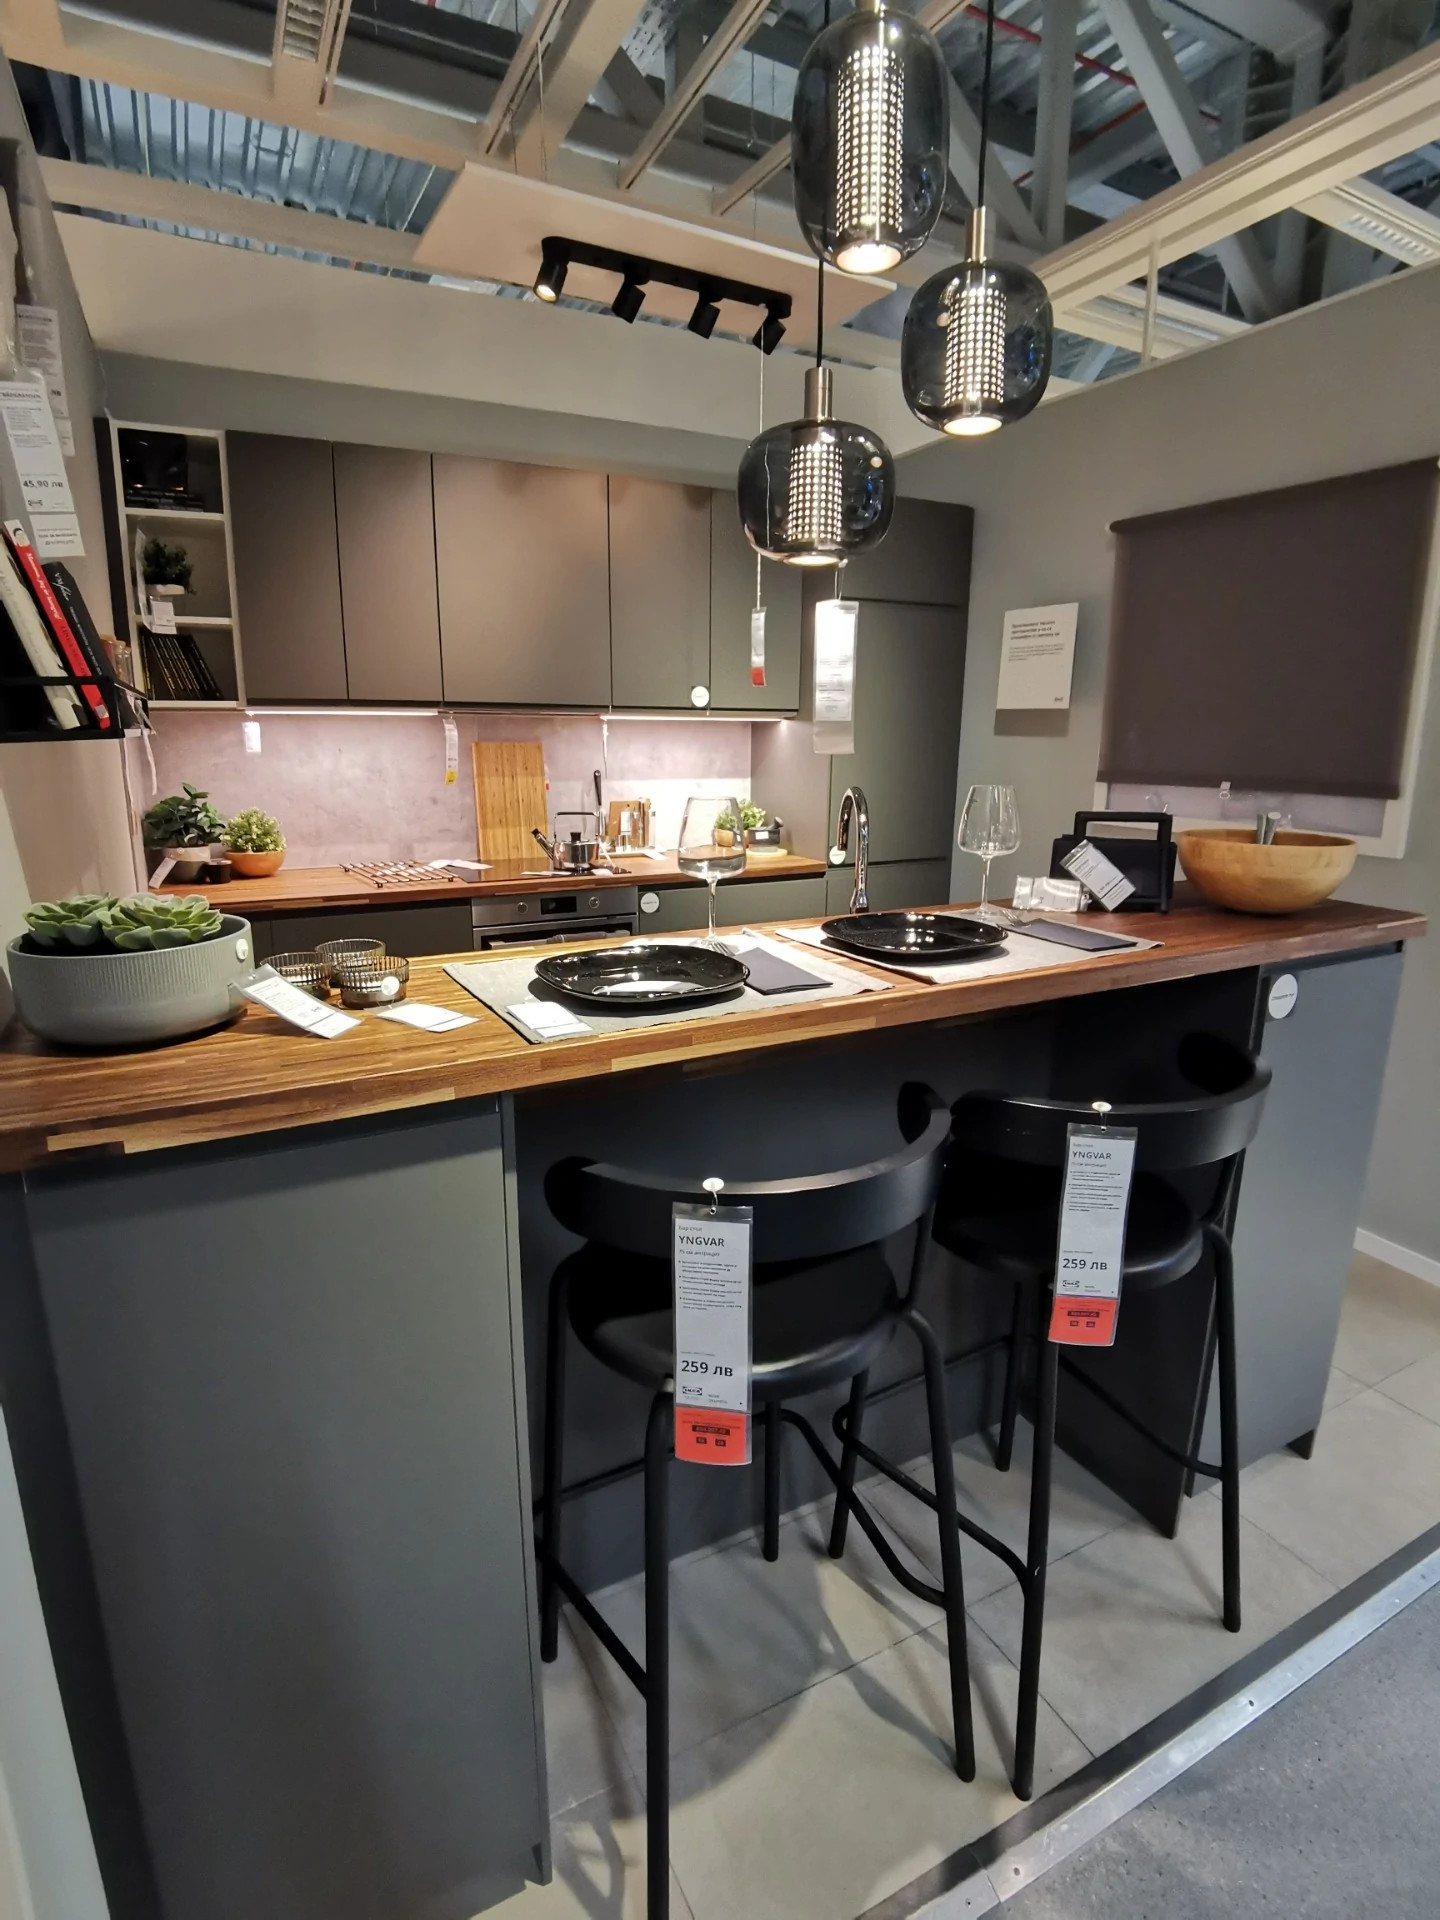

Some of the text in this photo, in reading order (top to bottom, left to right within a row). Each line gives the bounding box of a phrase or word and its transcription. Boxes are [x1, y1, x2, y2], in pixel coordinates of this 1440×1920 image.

[1072, 1150, 1112, 1160] YNGVAR
[678, 1235, 725, 1247] YNGVAR
[1062, 1258, 1108, 1270] 259 лв
[681, 1360, 734, 1377] 259 лв
